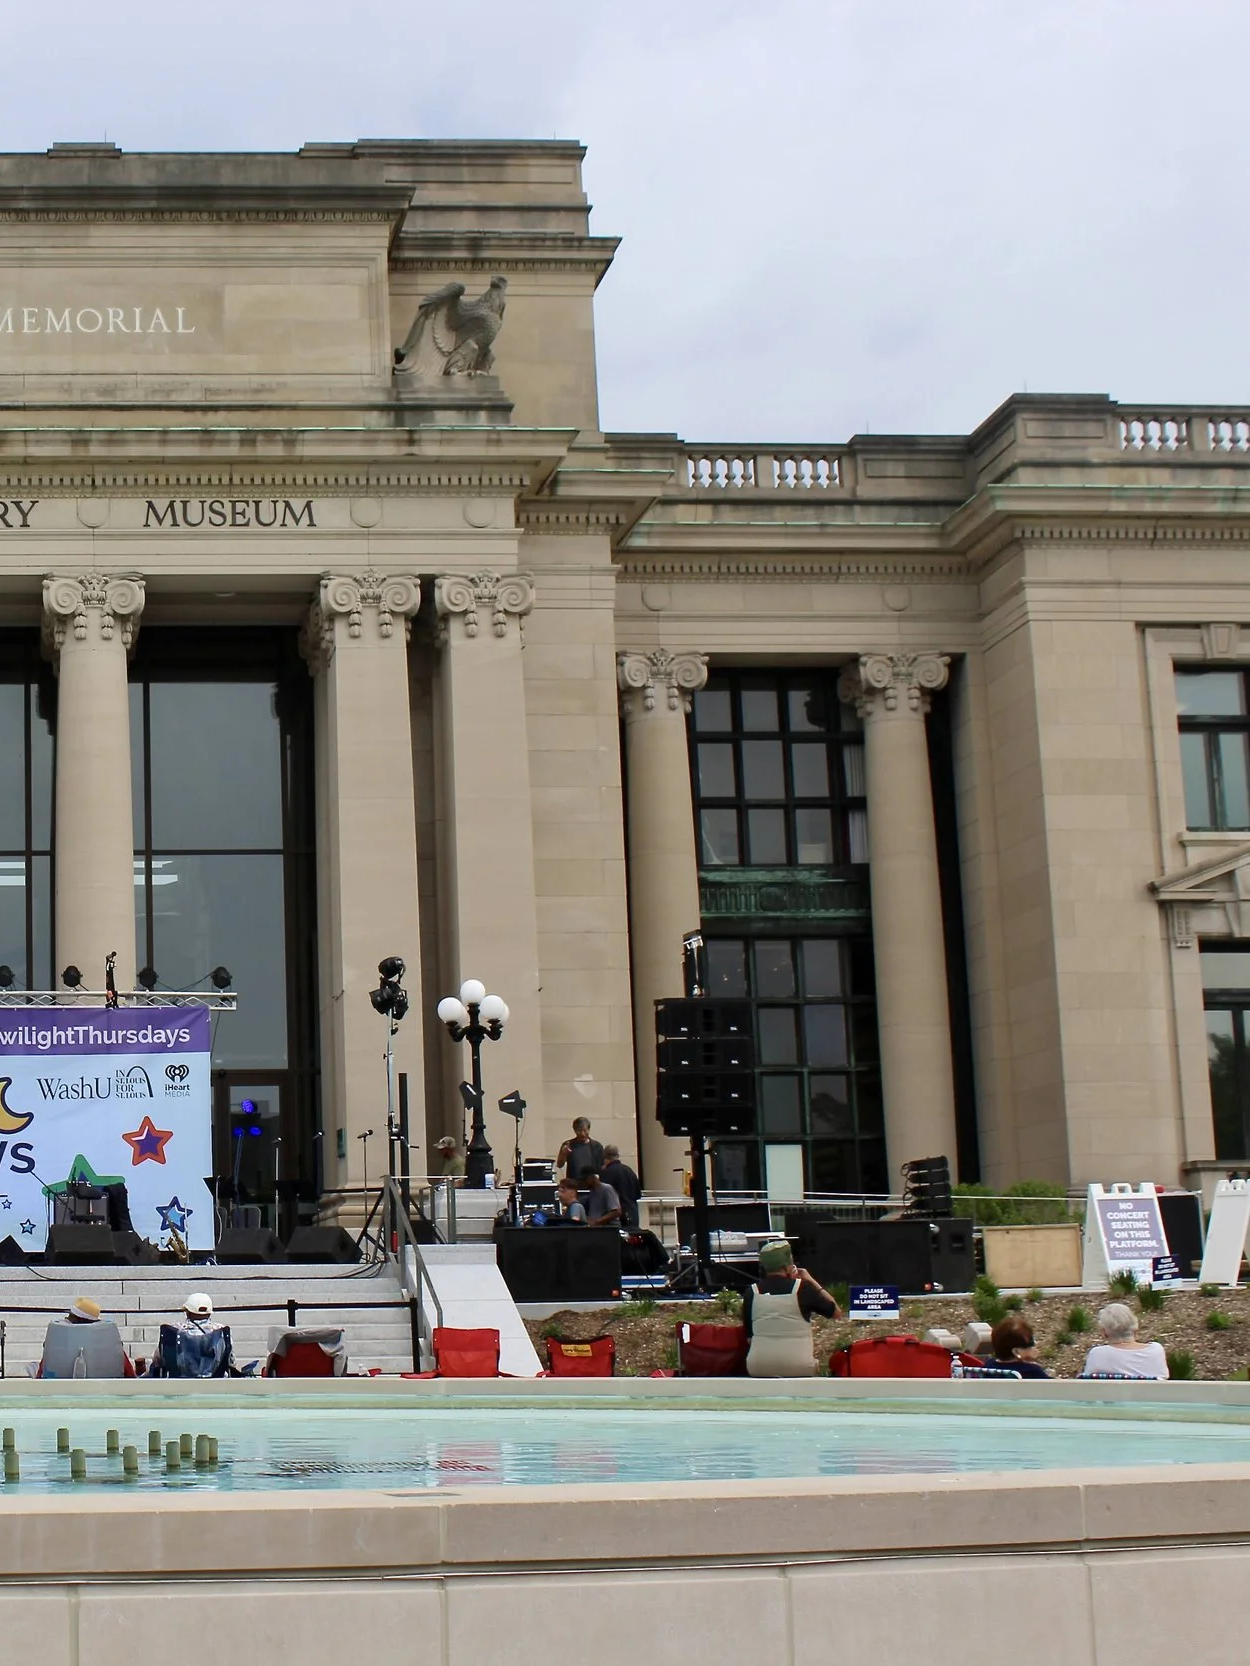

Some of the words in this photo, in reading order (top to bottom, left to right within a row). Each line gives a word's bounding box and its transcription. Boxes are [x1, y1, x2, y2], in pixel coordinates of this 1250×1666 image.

[142, 500, 317, 528] MUSEUM
[115, 1069, 126, 1077] IN
[36, 1076, 112, 1100] WashU
[115, 1084, 134, 1092] FOR
[1106, 1212, 1150, 1220] CONCERT
[1110, 1221, 1150, 1229] SEATING
[1110, 1240, 1160, 1248] PLATFORM.
